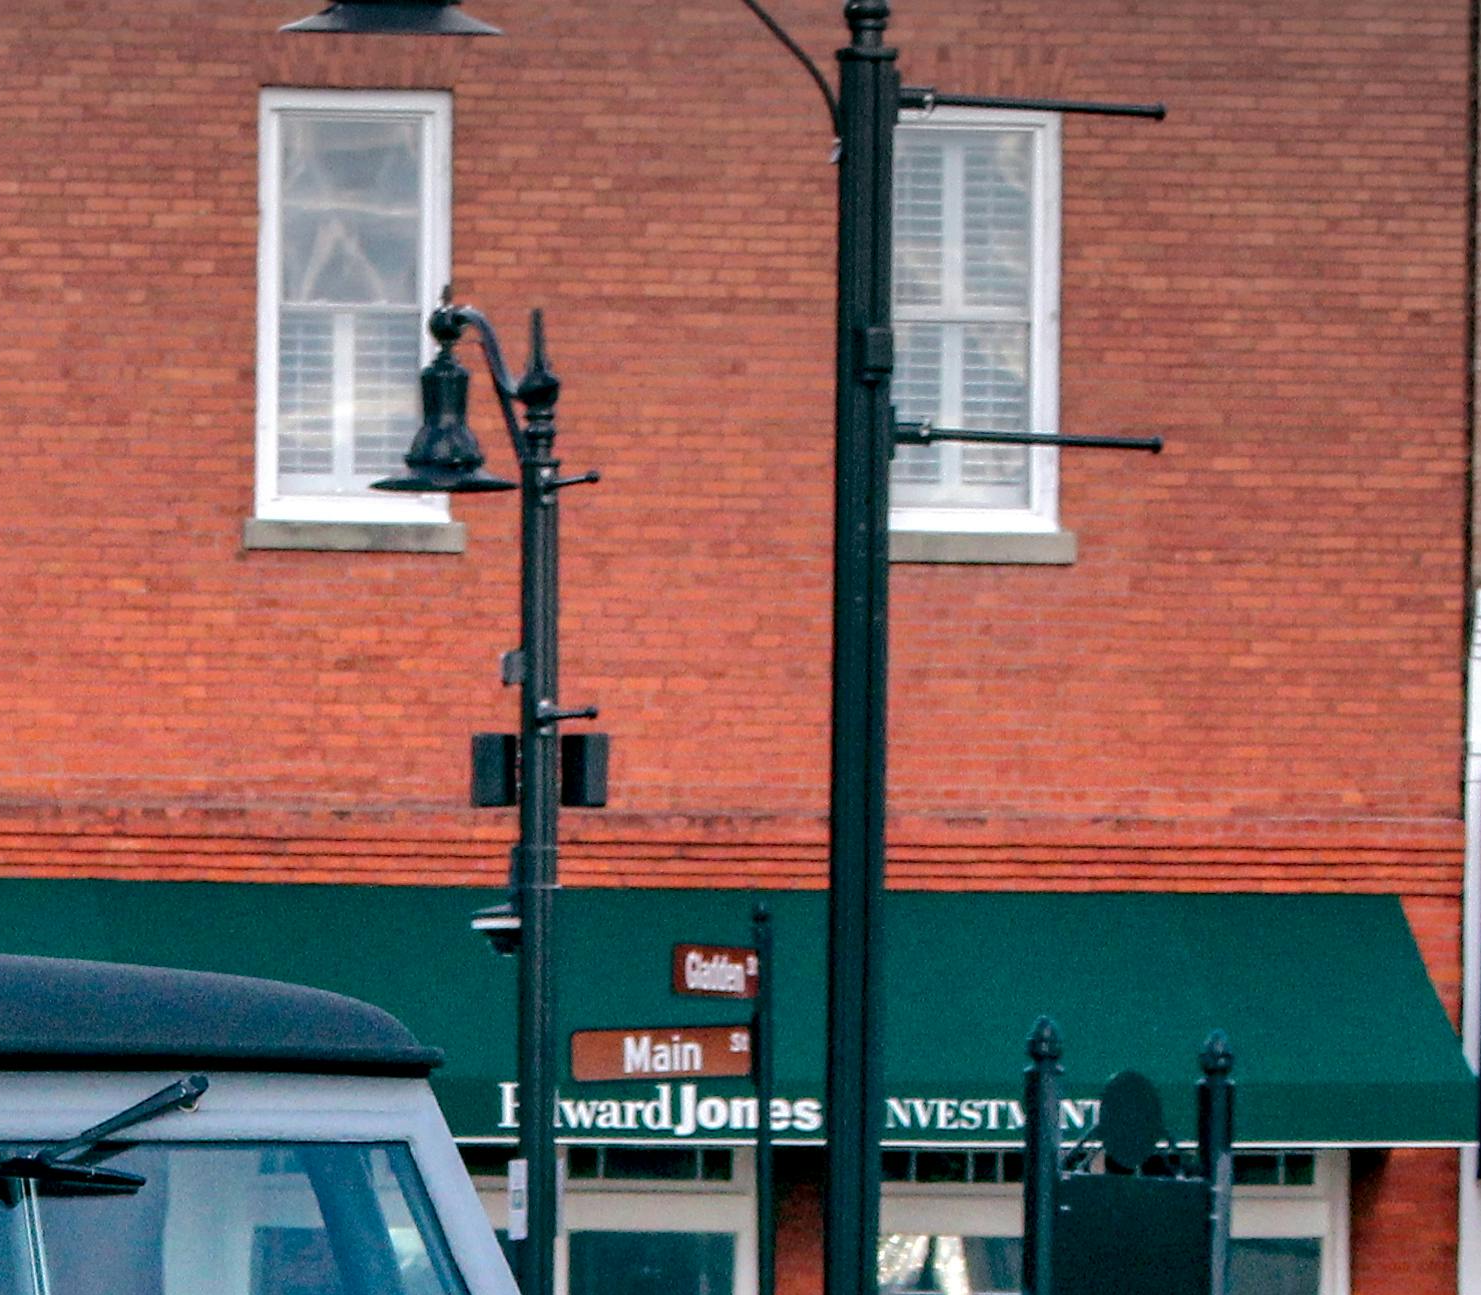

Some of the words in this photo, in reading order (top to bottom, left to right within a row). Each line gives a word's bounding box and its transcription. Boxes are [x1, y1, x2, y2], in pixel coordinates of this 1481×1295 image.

[685, 951, 746, 992] Gladden
[623, 1035, 703, 1074] Main
[729, 1033, 750, 1053] St
